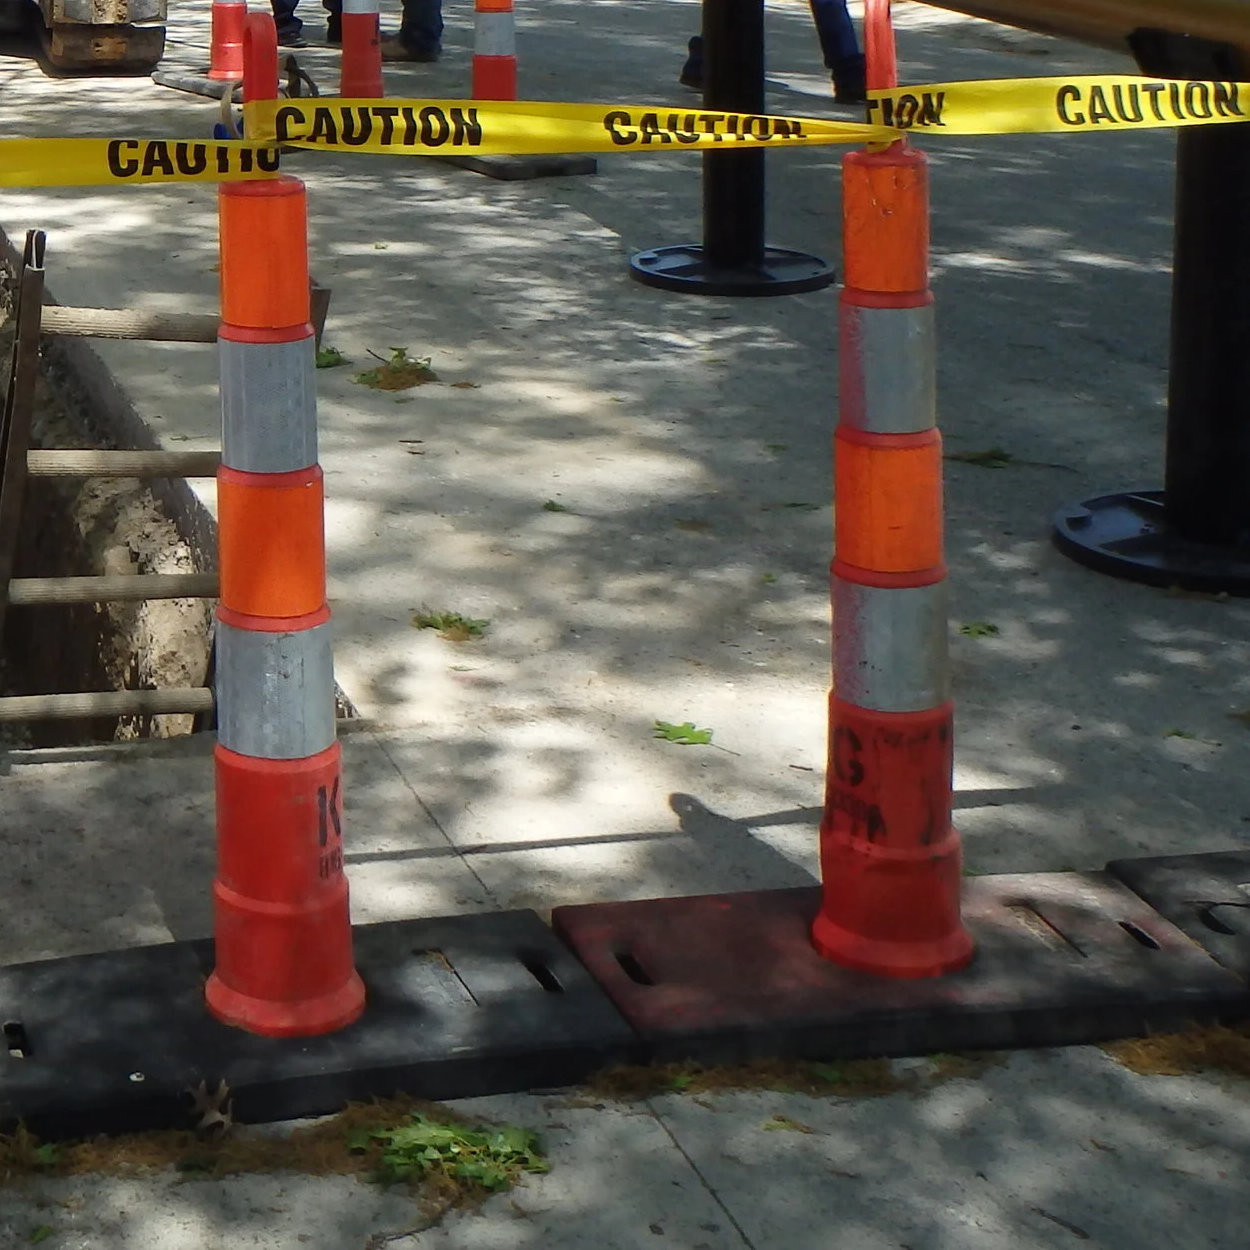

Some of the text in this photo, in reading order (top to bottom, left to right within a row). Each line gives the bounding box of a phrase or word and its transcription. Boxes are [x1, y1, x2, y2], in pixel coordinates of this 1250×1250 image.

[1056, 81, 1246, 126] CAUTION
[276, 106, 482, 147] CAUTION
[603, 111, 808, 145] CAUTION
